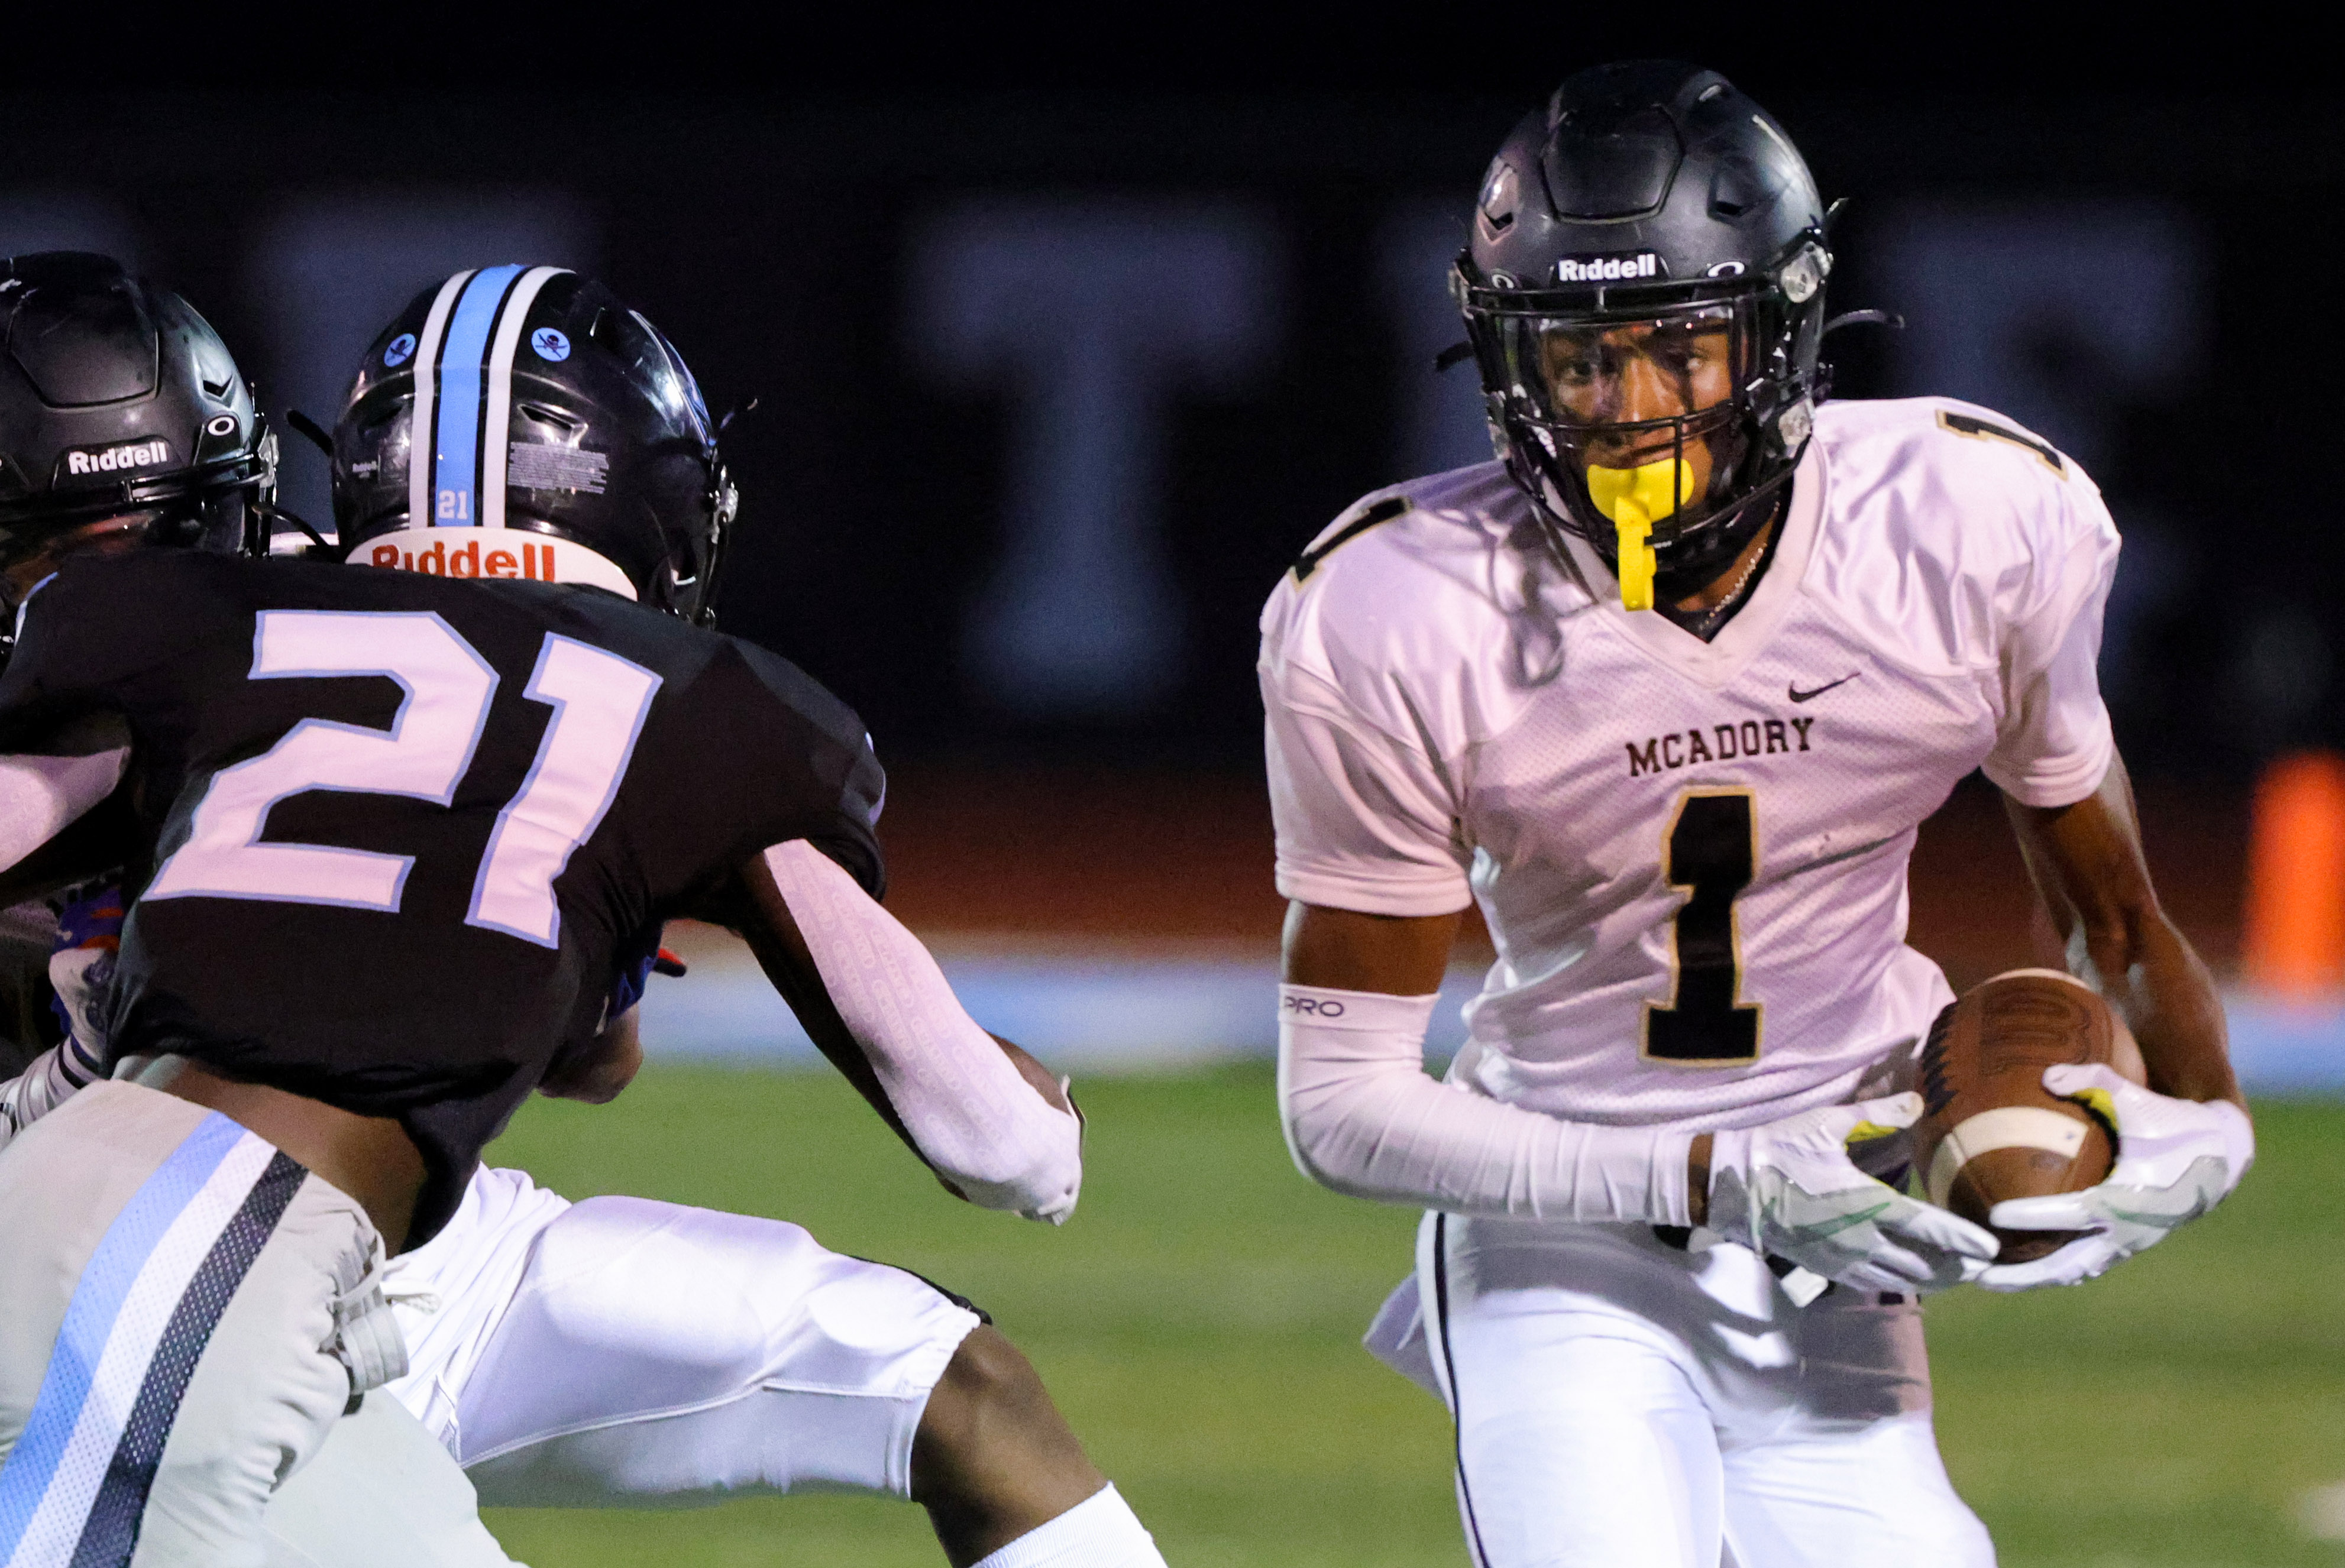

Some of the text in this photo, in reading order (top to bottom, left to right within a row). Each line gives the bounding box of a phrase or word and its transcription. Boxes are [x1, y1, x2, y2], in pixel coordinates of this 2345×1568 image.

[1558, 254, 1655, 281] Riddell
[69, 440, 168, 475] Riddell
[439, 490, 468, 520] 21
[1625, 716, 1814, 777] MCADORY
[140, 609, 664, 950] 21
[1639, 784, 1765, 1066] 1
